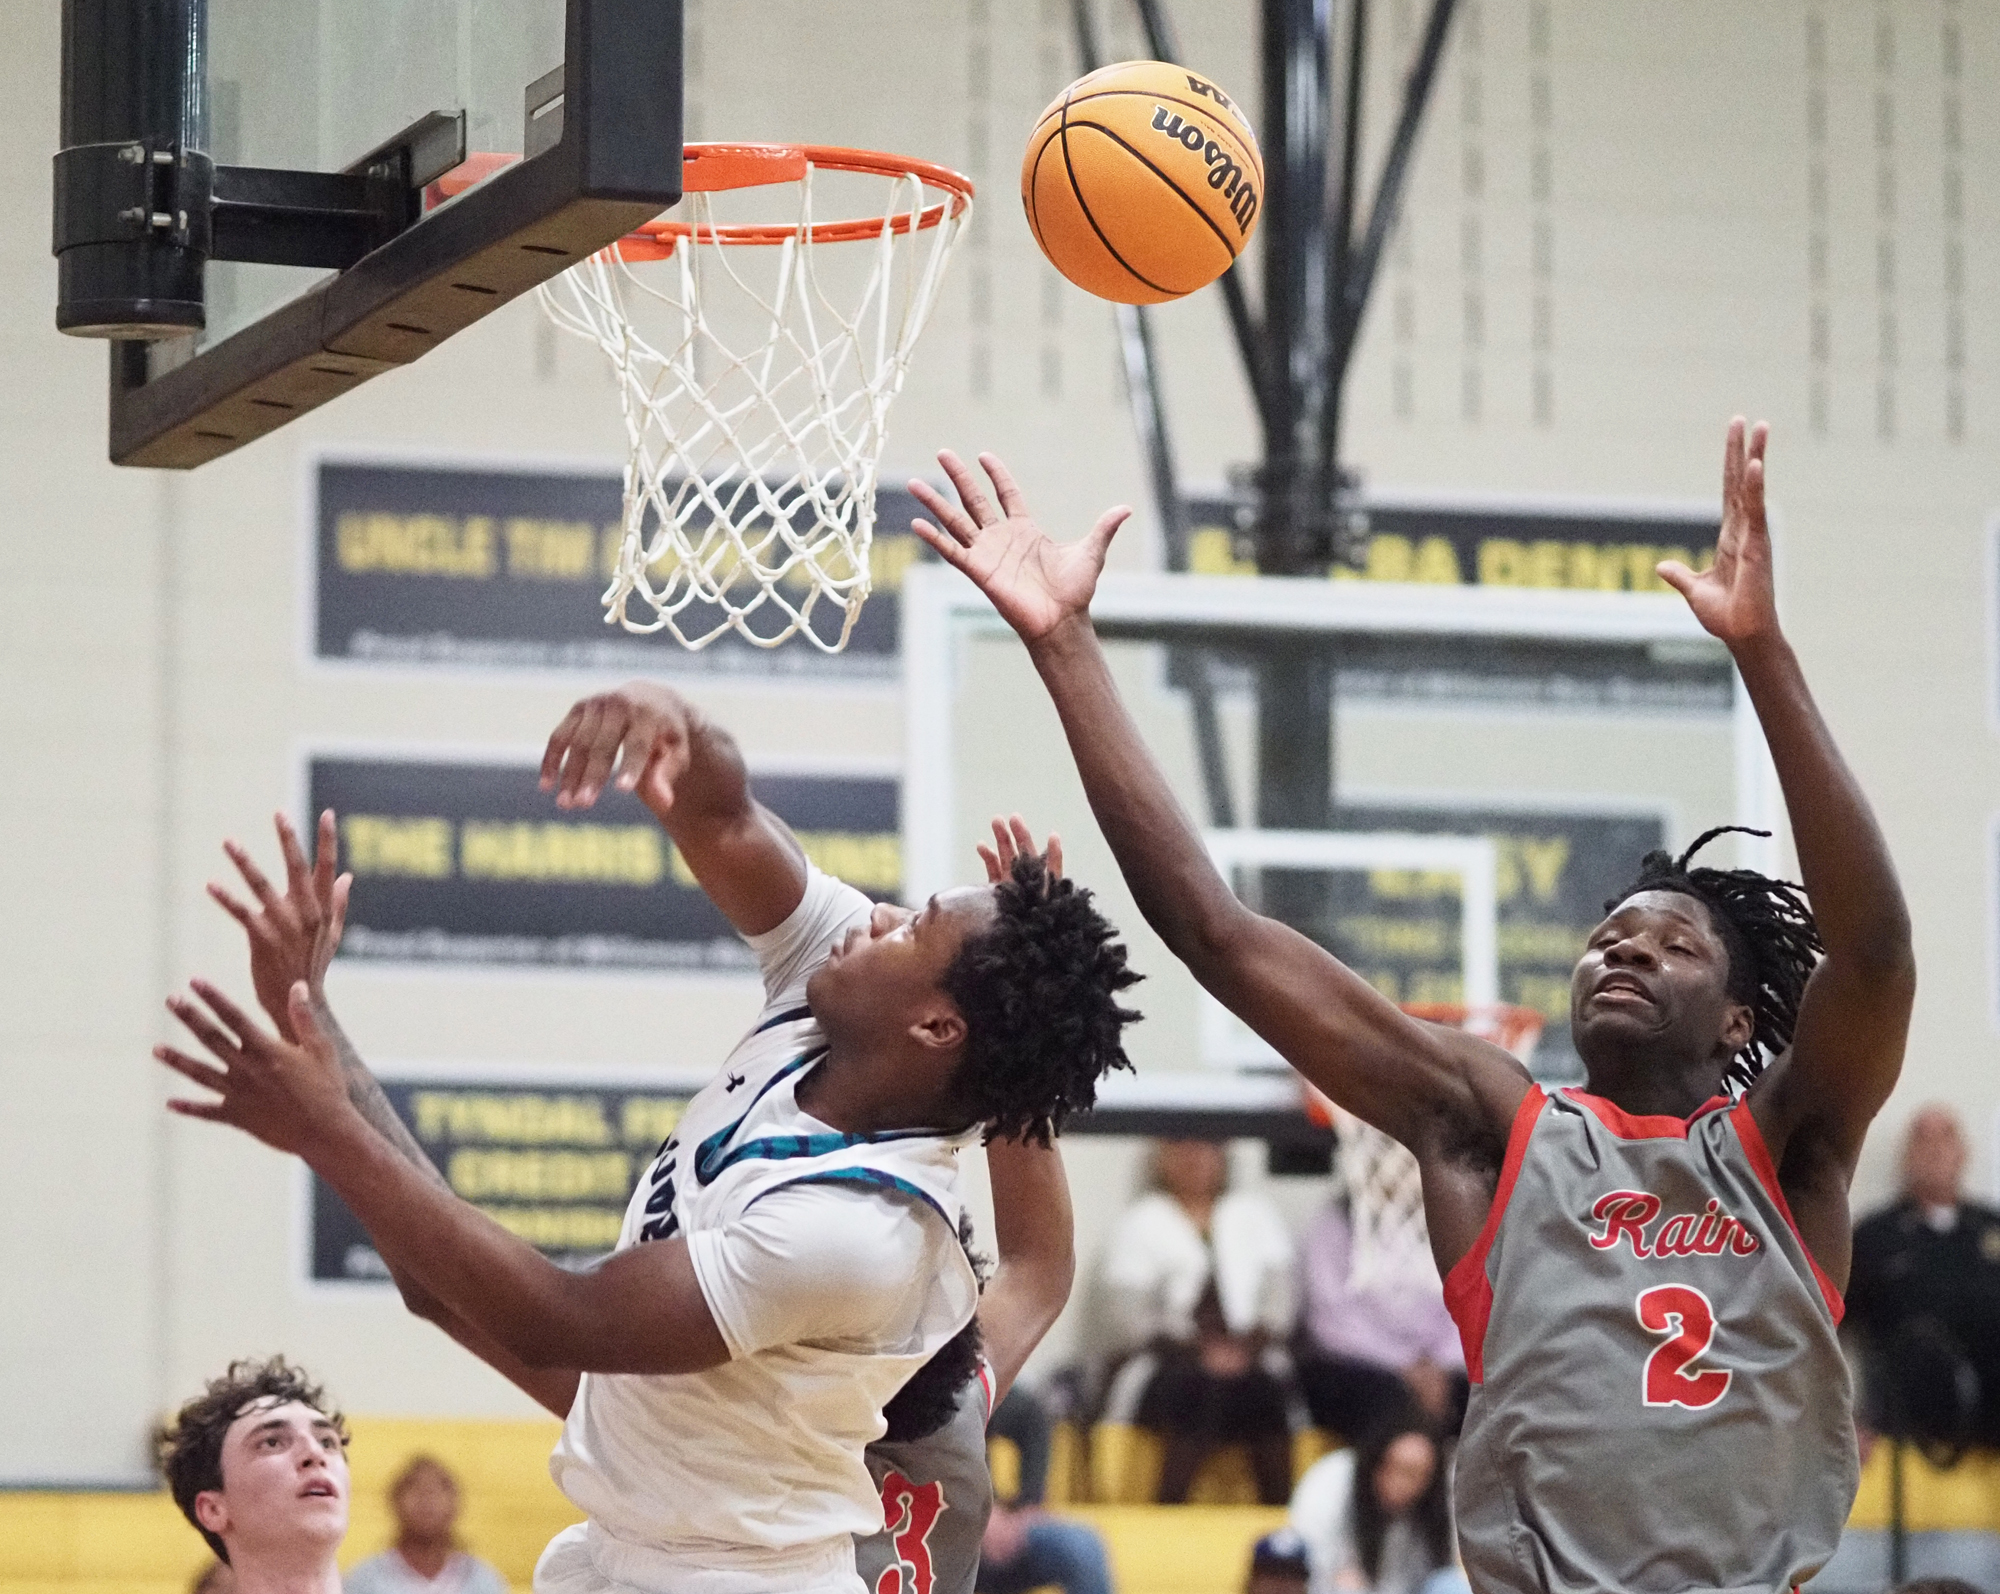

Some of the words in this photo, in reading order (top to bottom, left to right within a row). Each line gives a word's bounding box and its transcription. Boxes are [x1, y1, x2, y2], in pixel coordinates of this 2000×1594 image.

[1150, 105, 1257, 237] Wilson
[337, 510, 495, 578] UNCLE
[343, 813, 451, 880] THE
[1588, 1189, 1759, 1259] Rain
[1635, 1283, 1733, 1410] 2
